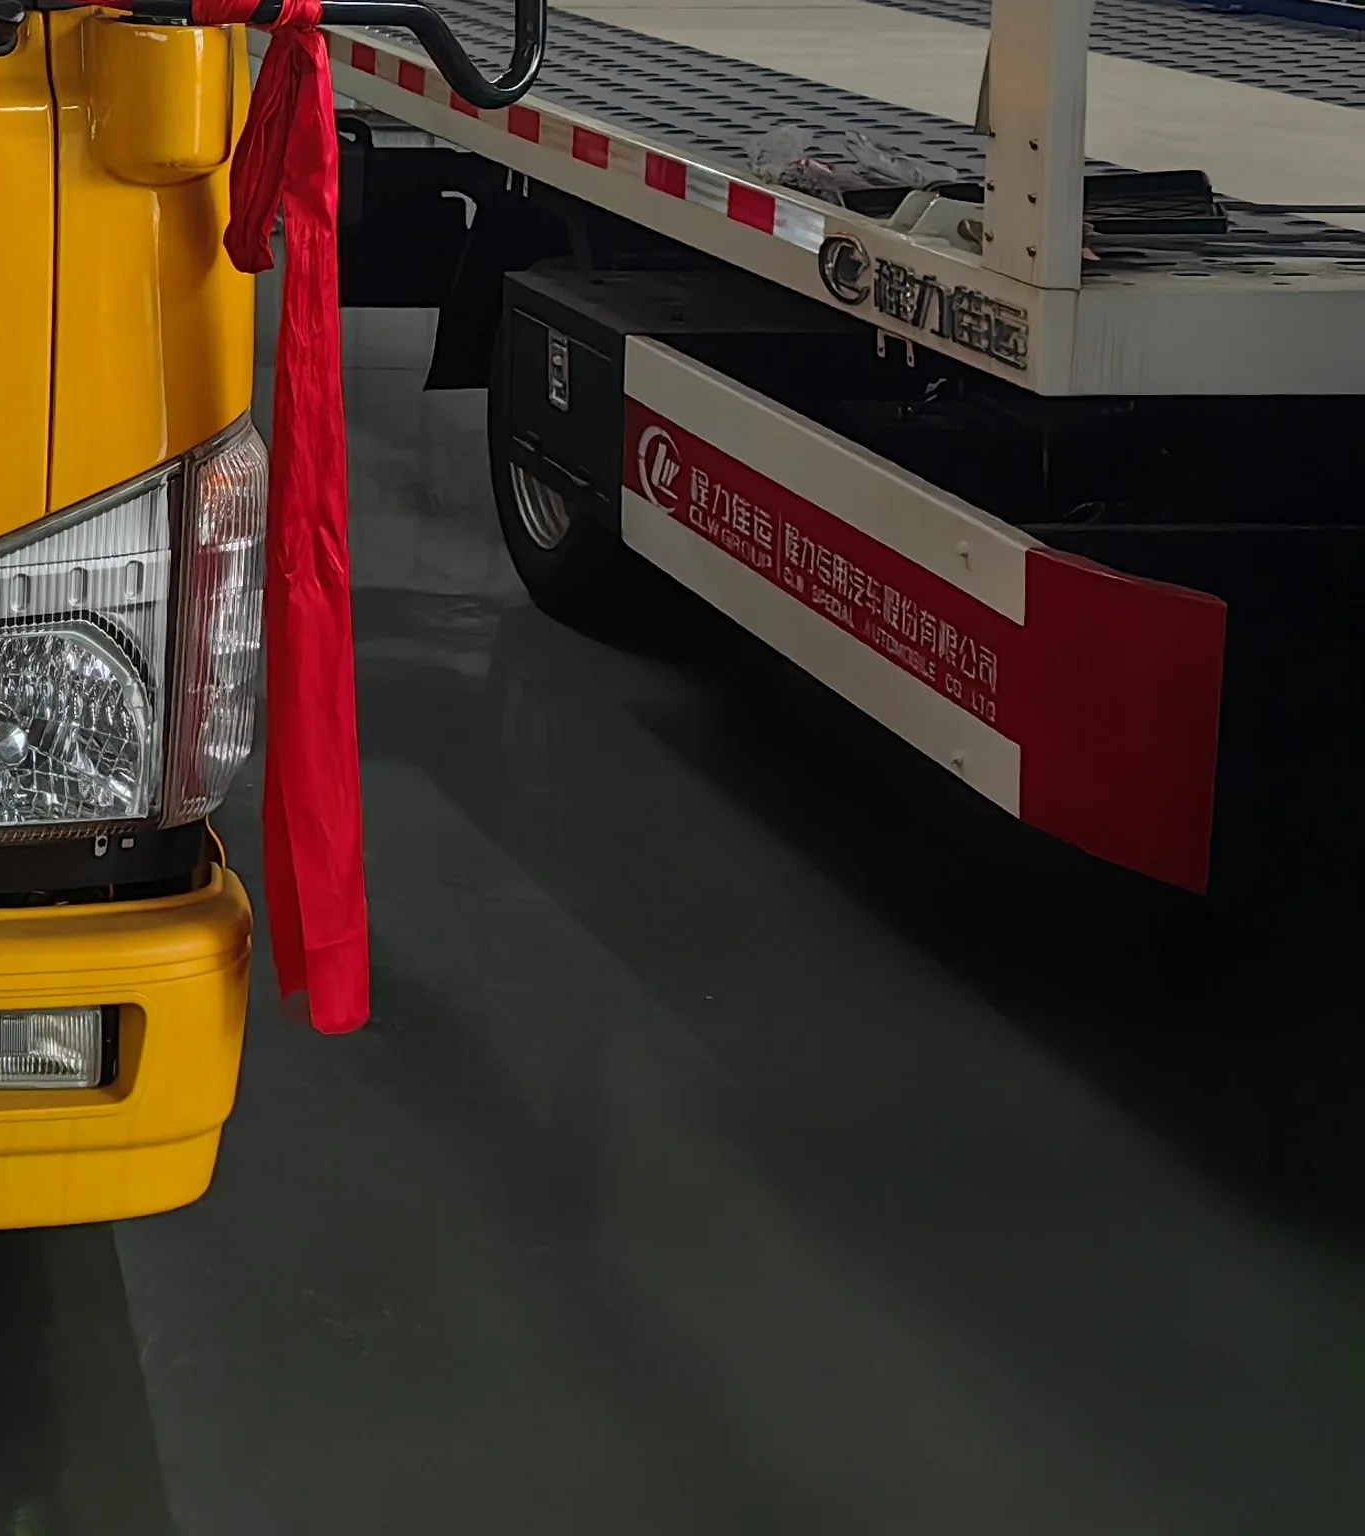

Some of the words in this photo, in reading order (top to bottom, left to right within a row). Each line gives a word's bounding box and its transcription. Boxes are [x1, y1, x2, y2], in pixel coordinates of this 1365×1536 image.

[689, 466, 774, 551] 程力佳运
[721, 528, 773, 569] GROUP
[784, 521, 998, 695] 程力专用汽车股份有限公司
